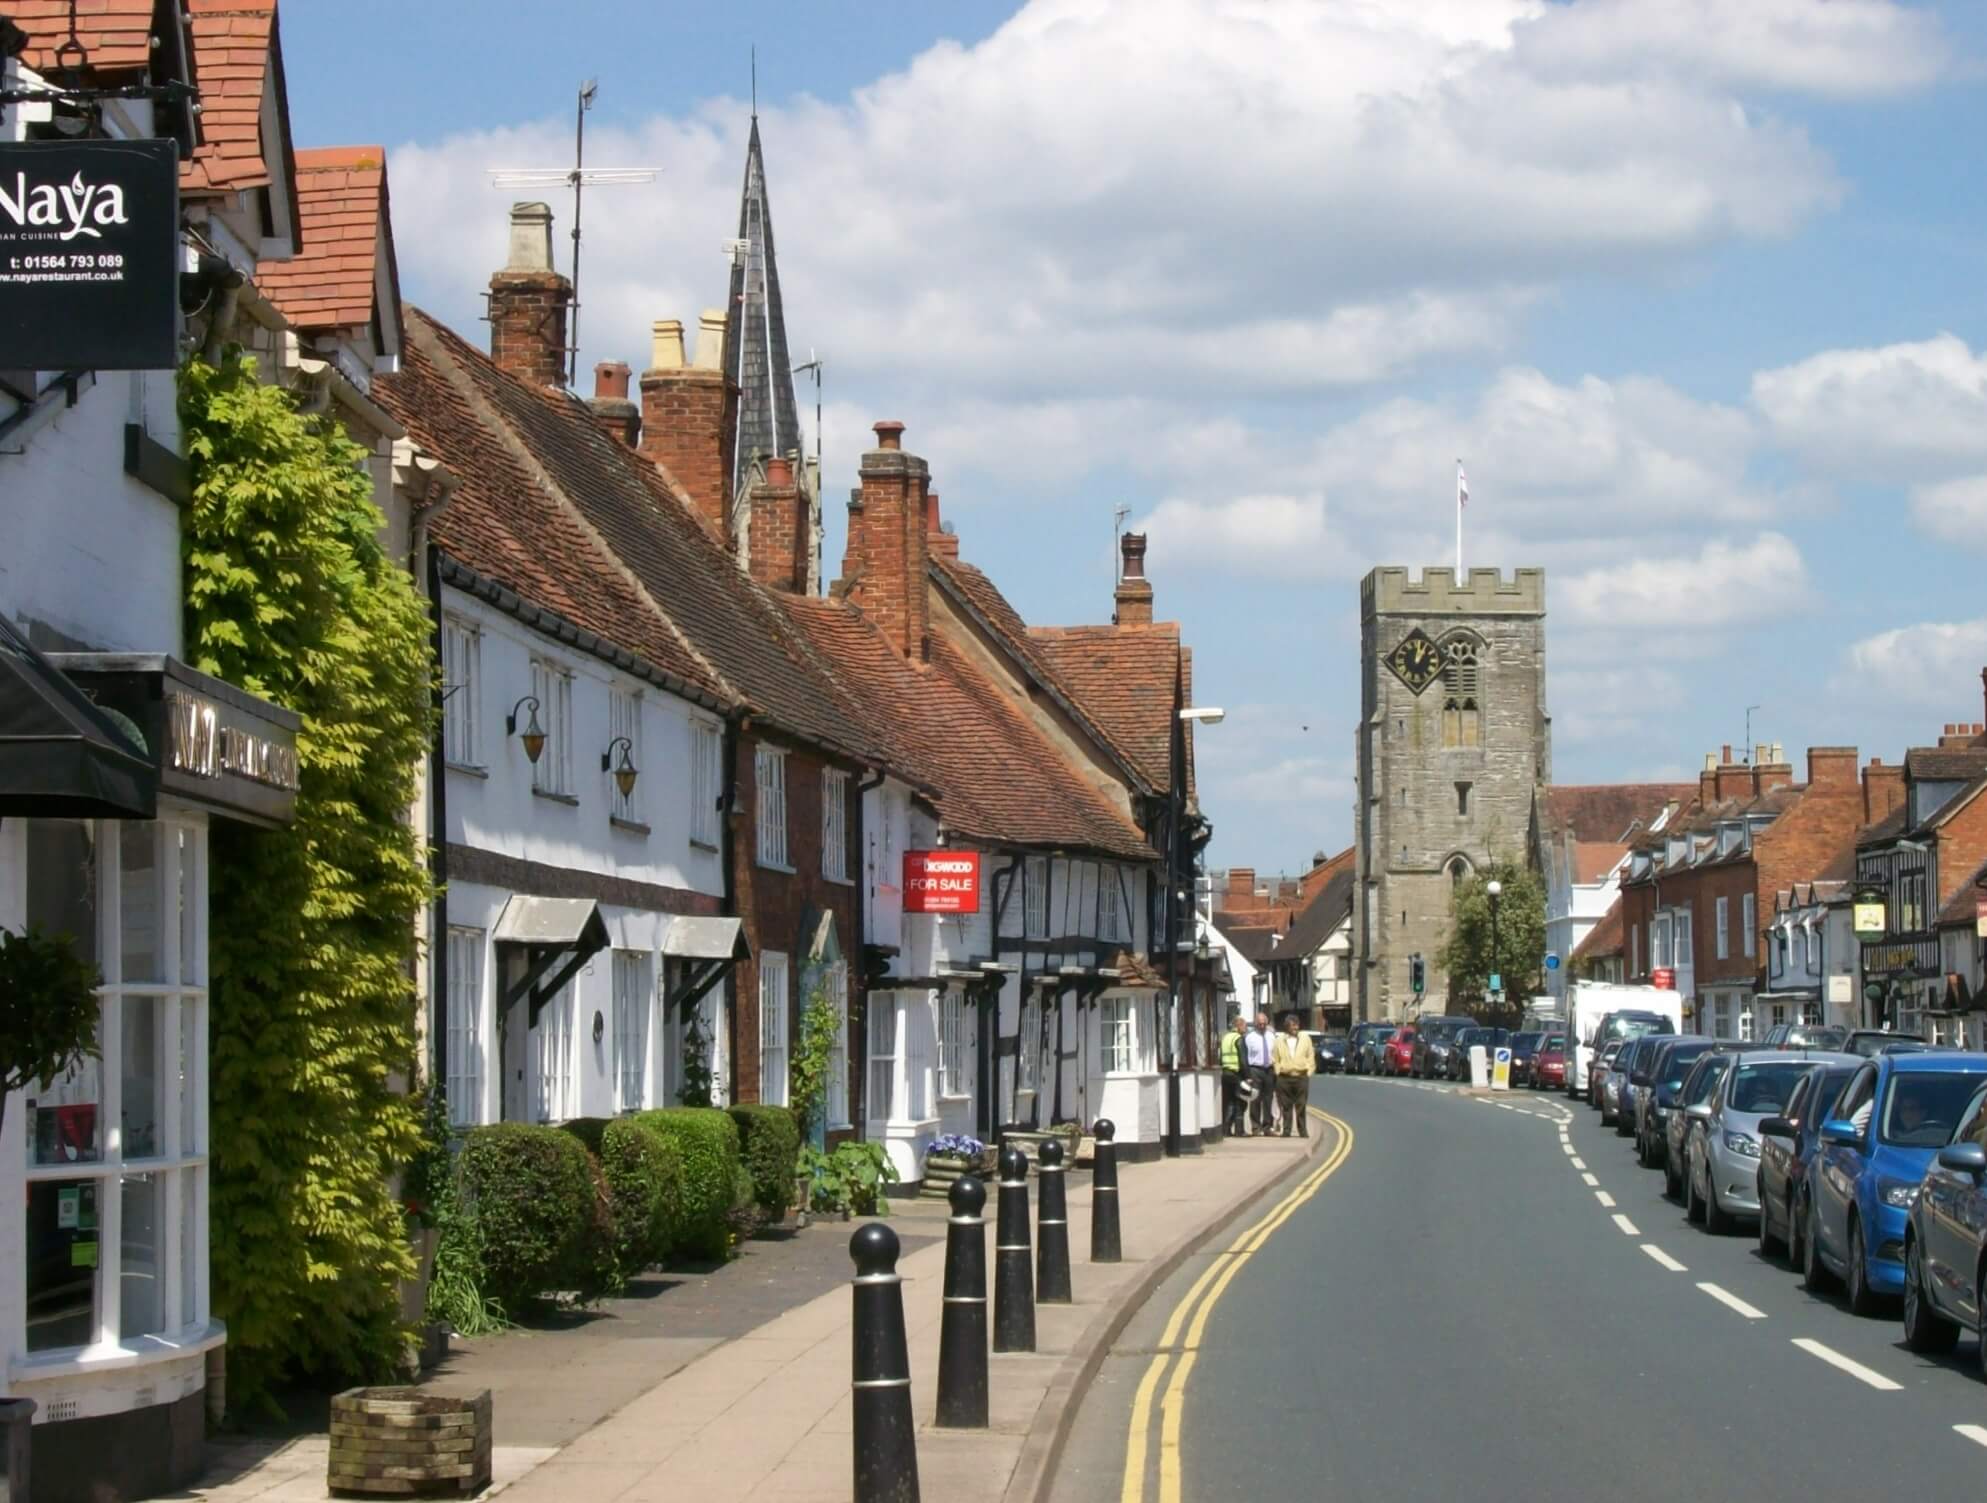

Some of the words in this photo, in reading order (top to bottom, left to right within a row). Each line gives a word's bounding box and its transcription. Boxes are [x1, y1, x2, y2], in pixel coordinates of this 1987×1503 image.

[0, 171, 129, 240] Naya
[20, 232, 60, 240] CUISINE
[10, 256, 21, 270] t:
[24, 256, 66, 269] 01564
[70, 255, 95, 268] 793
[98, 255, 124, 268] 089
[910, 879, 938, 891] FOR
[940, 878, 973, 891] SALE
